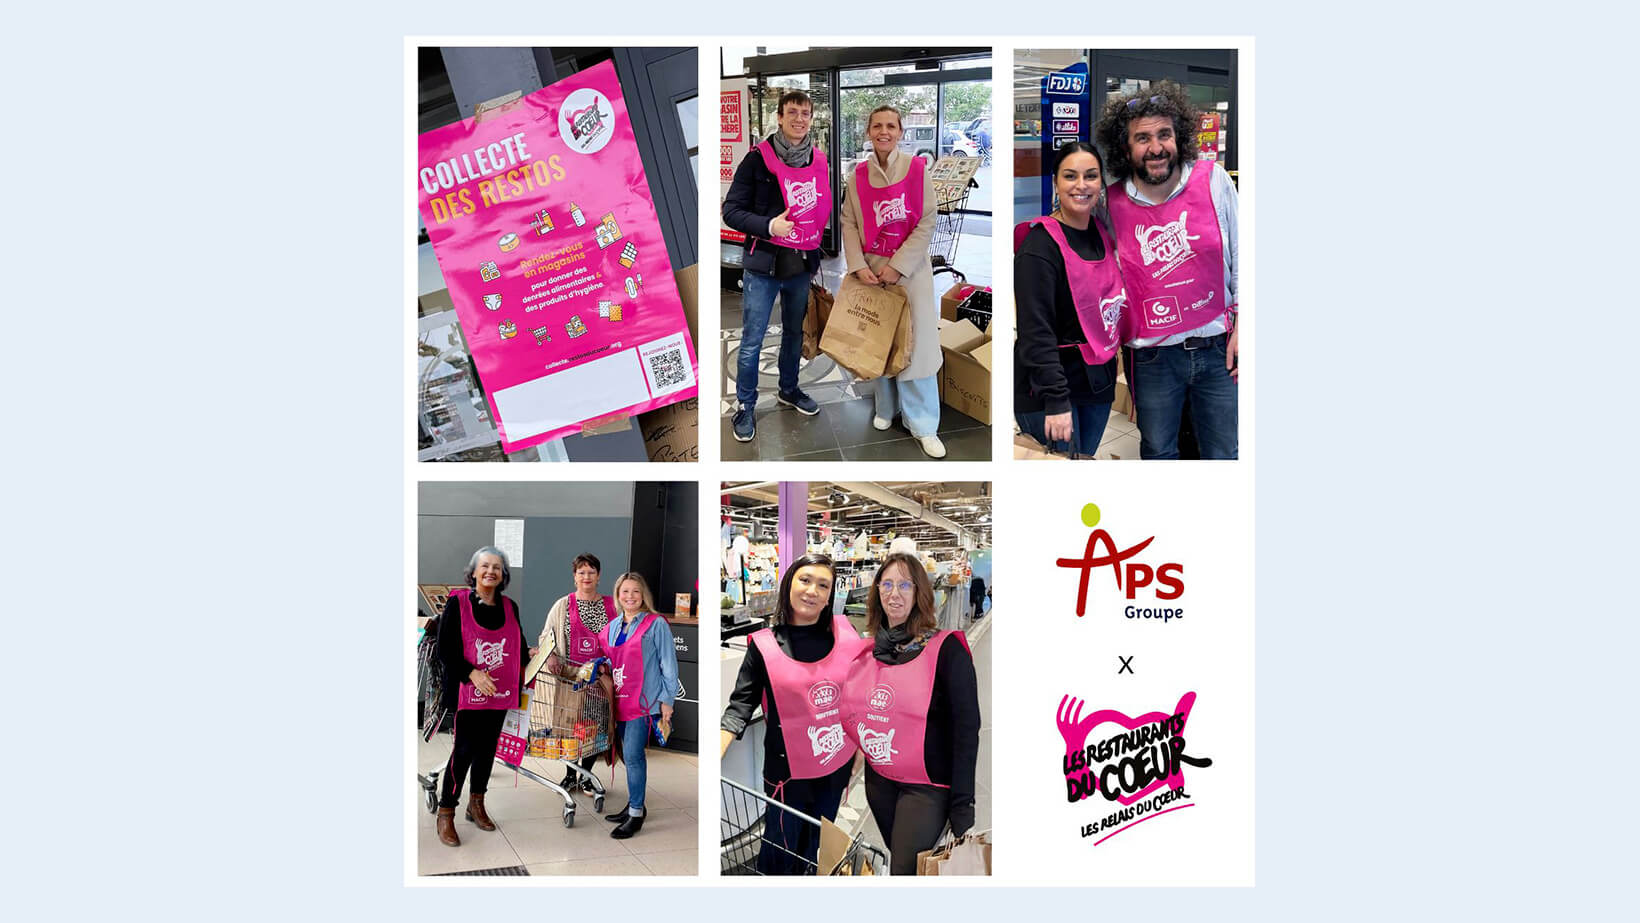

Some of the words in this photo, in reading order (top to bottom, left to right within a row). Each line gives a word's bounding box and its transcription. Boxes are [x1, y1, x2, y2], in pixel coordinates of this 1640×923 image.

[1050, 76, 1072, 90] FDJ
[419, 132, 532, 194] COLLECTE
[430, 188, 476, 225] DES
[478, 154, 566, 208] RESTOS
[520, 241, 583, 271] Rendez-vous
[523, 268, 537, 278] en
[537, 251, 586, 274] magasins
[531, 280, 547, 292] pour
[548, 270, 573, 284] donner
[574, 266, 587, 276] des
[551, 274, 596, 293] alimentaires
[525, 303, 538, 313] des
[538, 293, 568, 311] produits
[861, 307, 879, 319] mode
[847, 308, 866, 319] entre
[1150, 314, 1177, 326] MACIF
